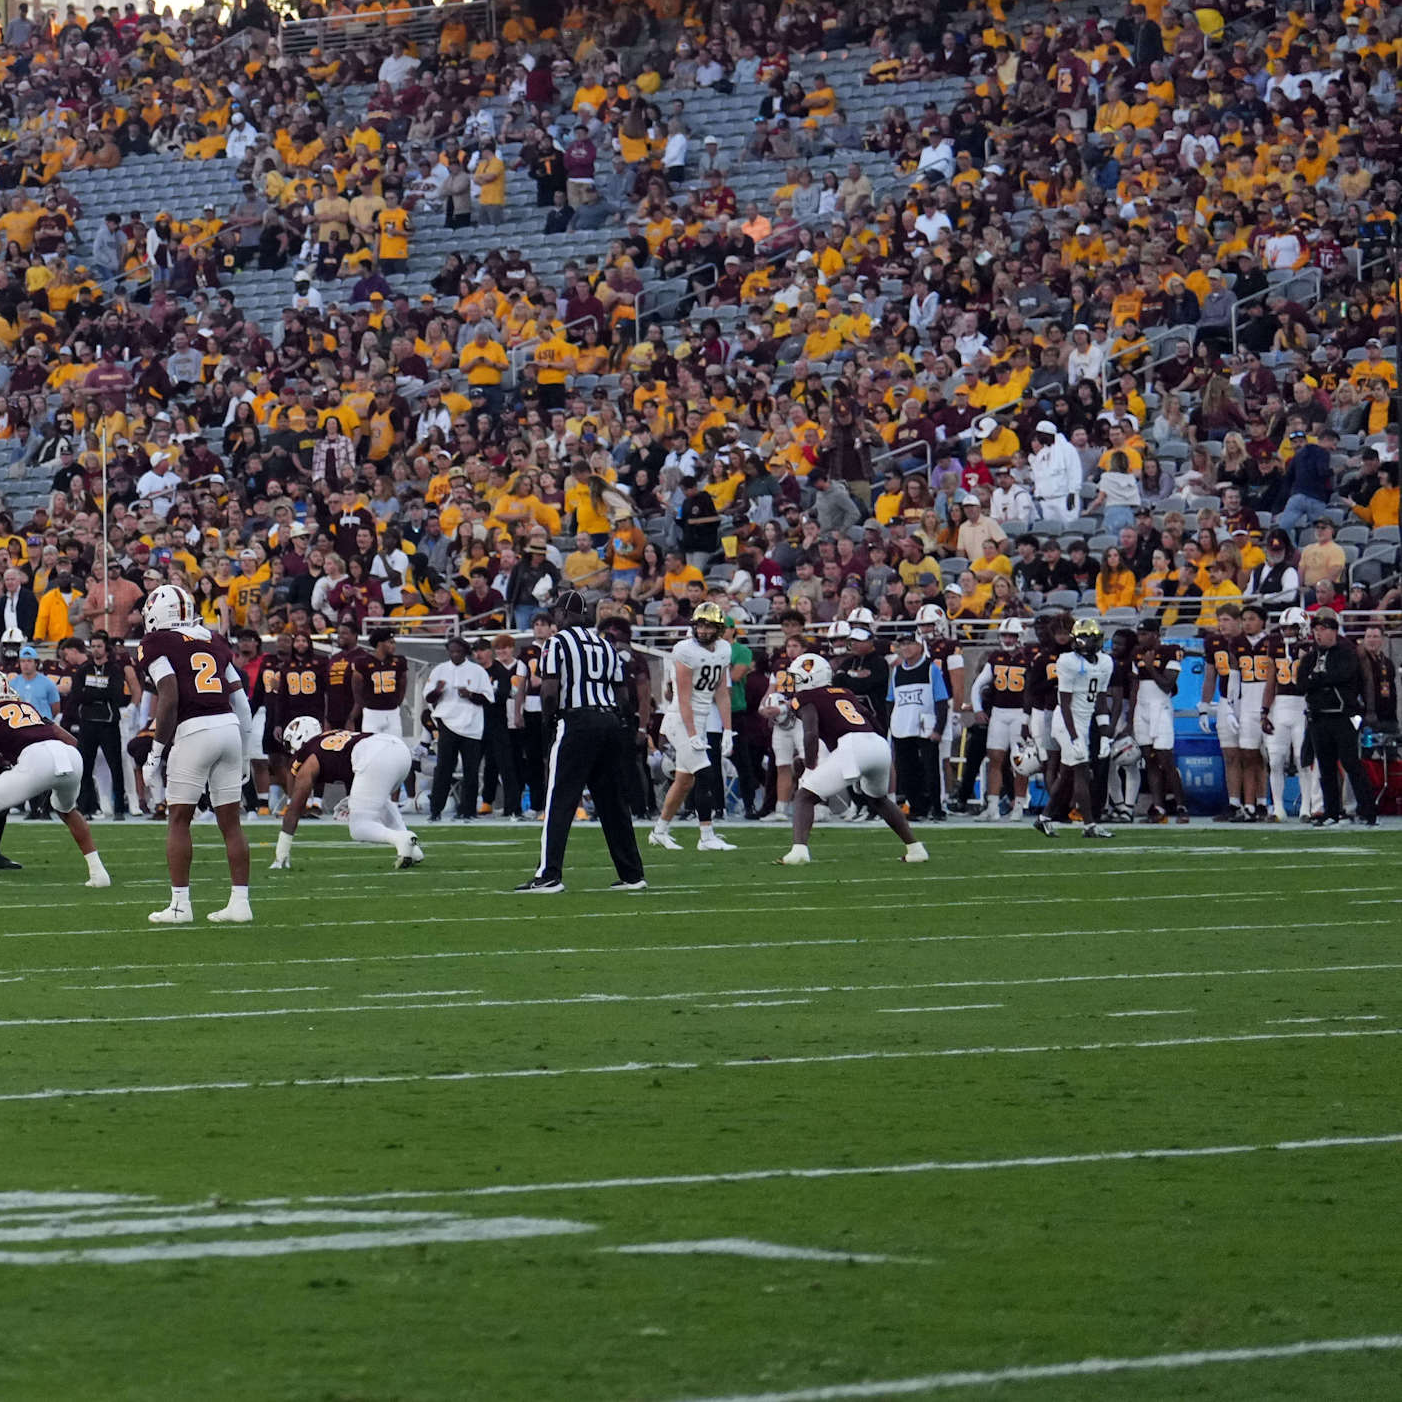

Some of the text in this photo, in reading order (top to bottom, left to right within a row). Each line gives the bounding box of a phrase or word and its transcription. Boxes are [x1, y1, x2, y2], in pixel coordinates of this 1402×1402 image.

[238, 589, 262, 607] 85
[190, 653, 223, 694] 2
[583, 645, 604, 681] U
[371, 670, 396, 694] 15
[695, 665, 723, 692] 80
[994, 665, 1026, 692] 35
[835, 699, 866, 725] 8
